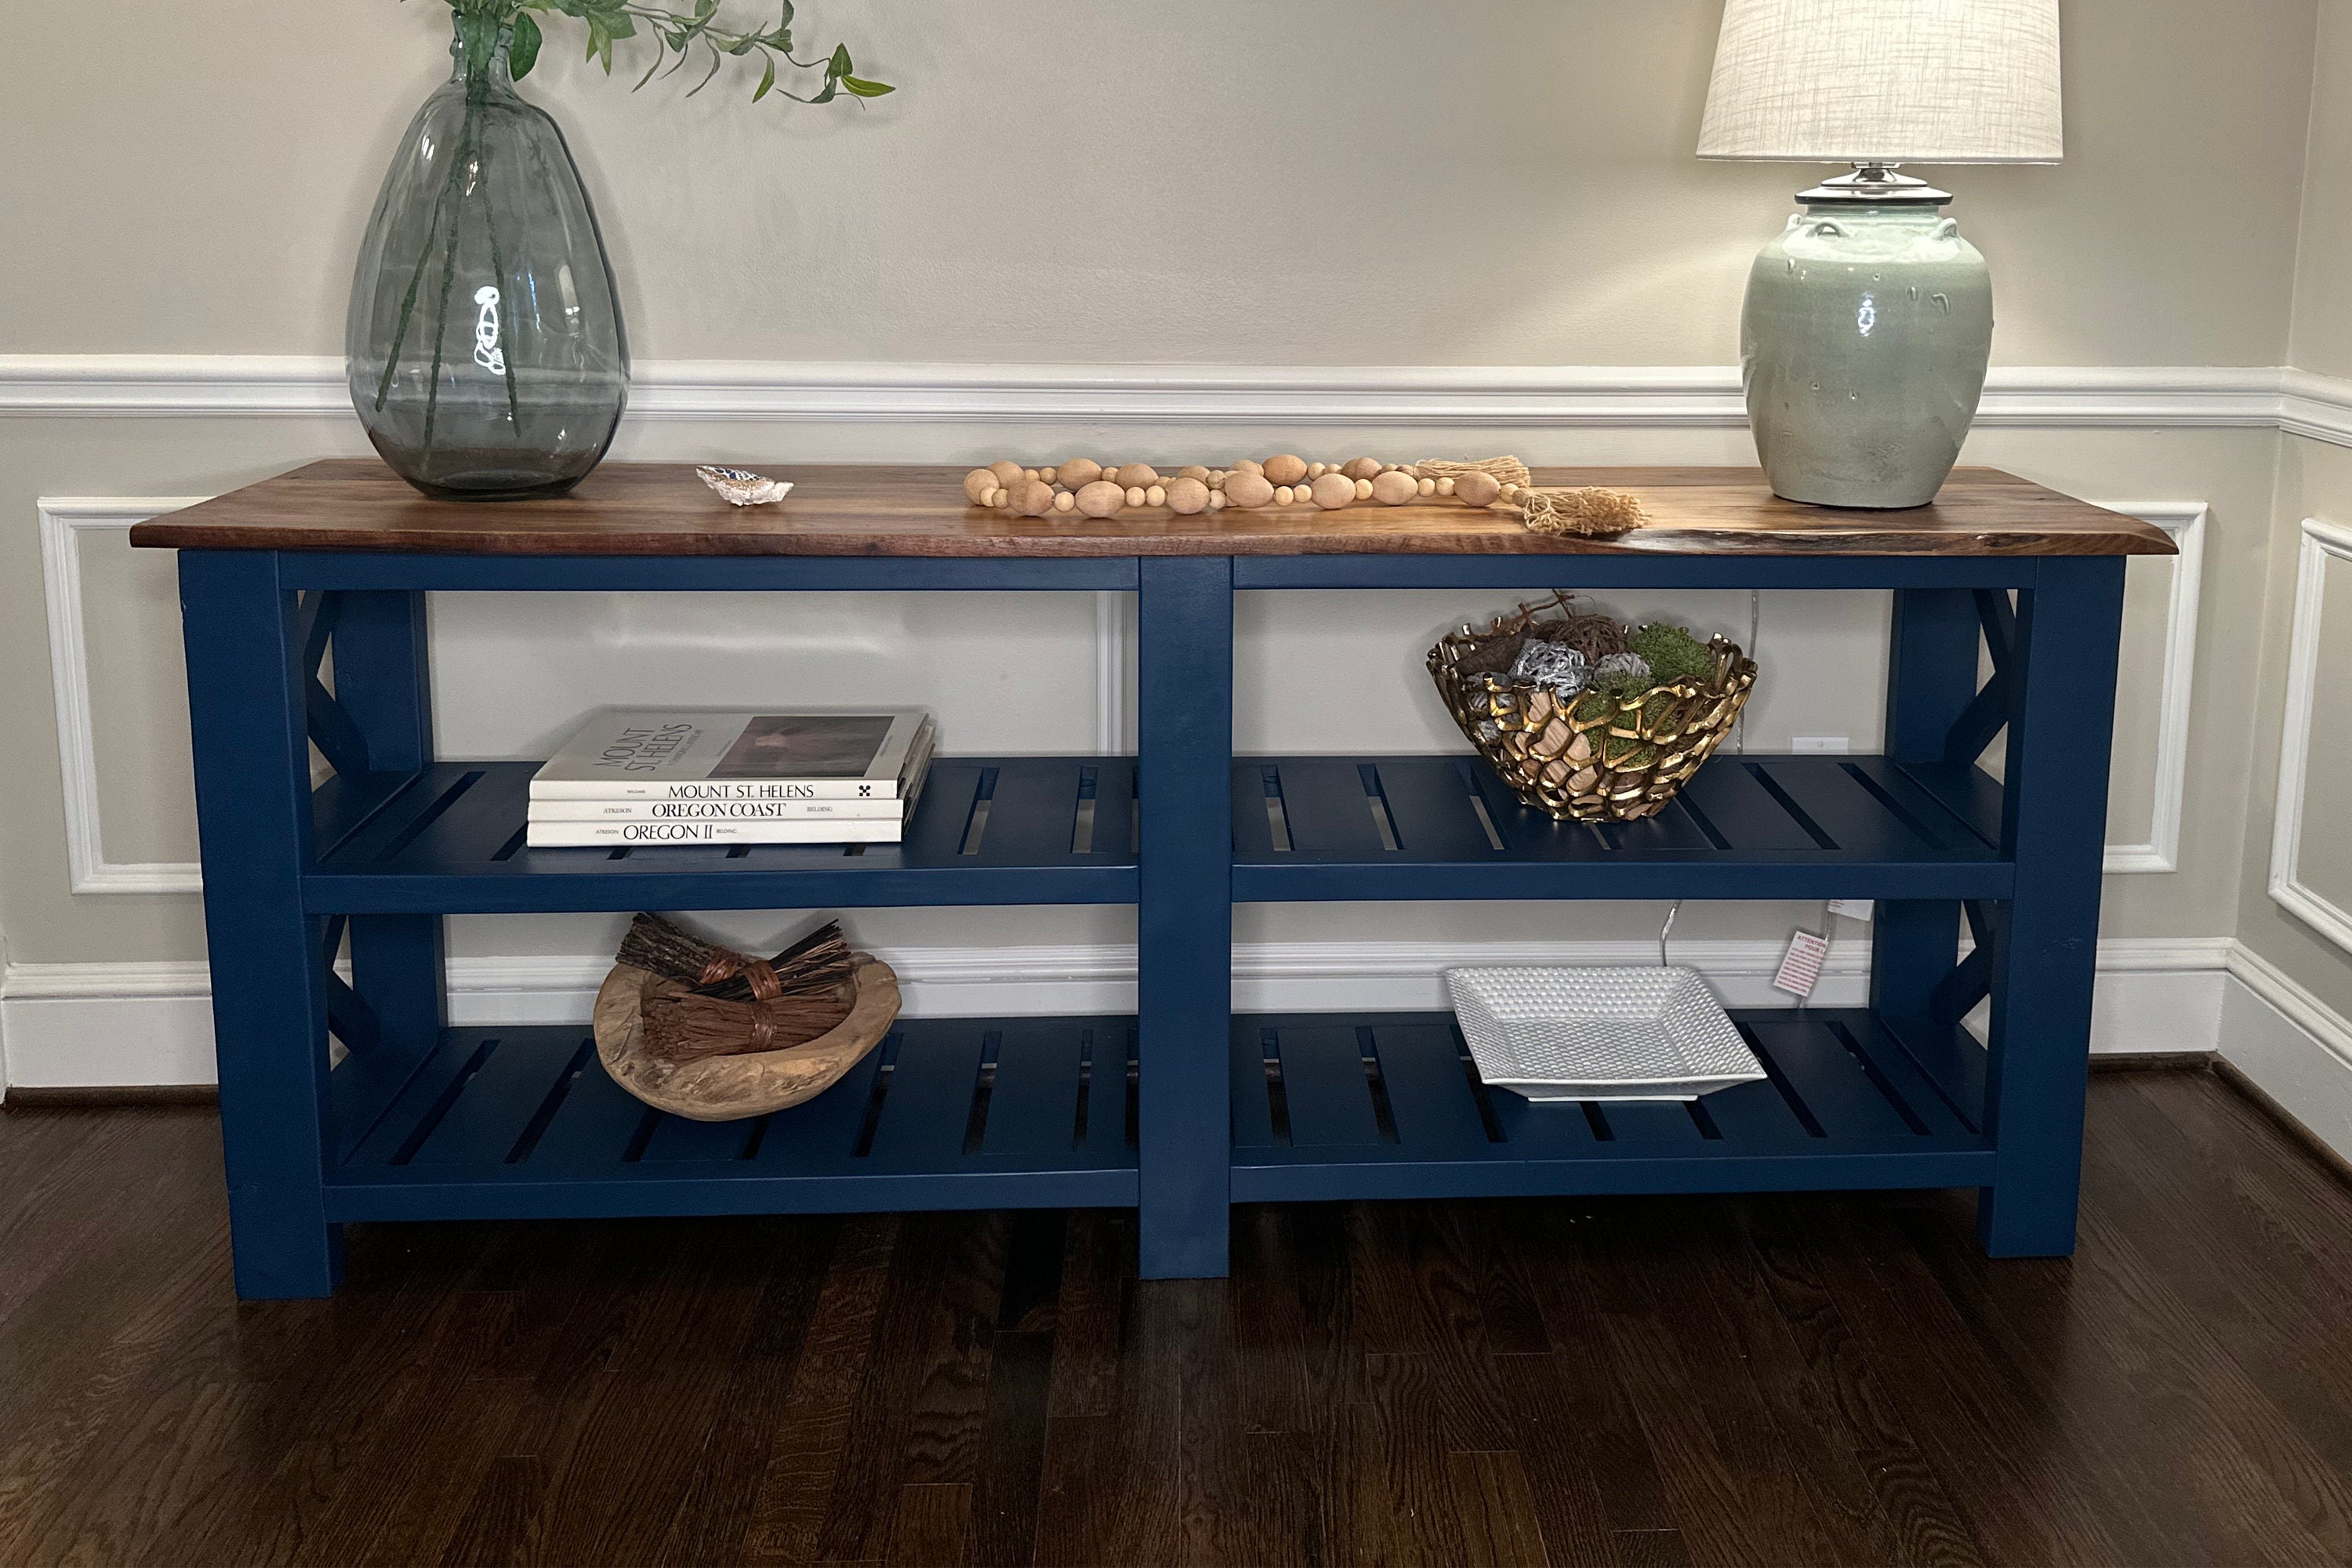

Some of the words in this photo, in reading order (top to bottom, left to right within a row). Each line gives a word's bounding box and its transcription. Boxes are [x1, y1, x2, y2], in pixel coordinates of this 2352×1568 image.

[592, 728, 655, 767] MOUNT
[636, 724, 692, 758] HELENS
[669, 785, 731, 798] MOUNT
[736, 785, 754, 797] ST.
[760, 785, 814, 798] HELENS
[652, 803, 727, 818] OREGON
[730, 803, 786, 817] COAST
[623, 824, 699, 840] OREGON
[704, 824, 713, 839] II
[1797, 935, 1827, 947] ATTENTION
